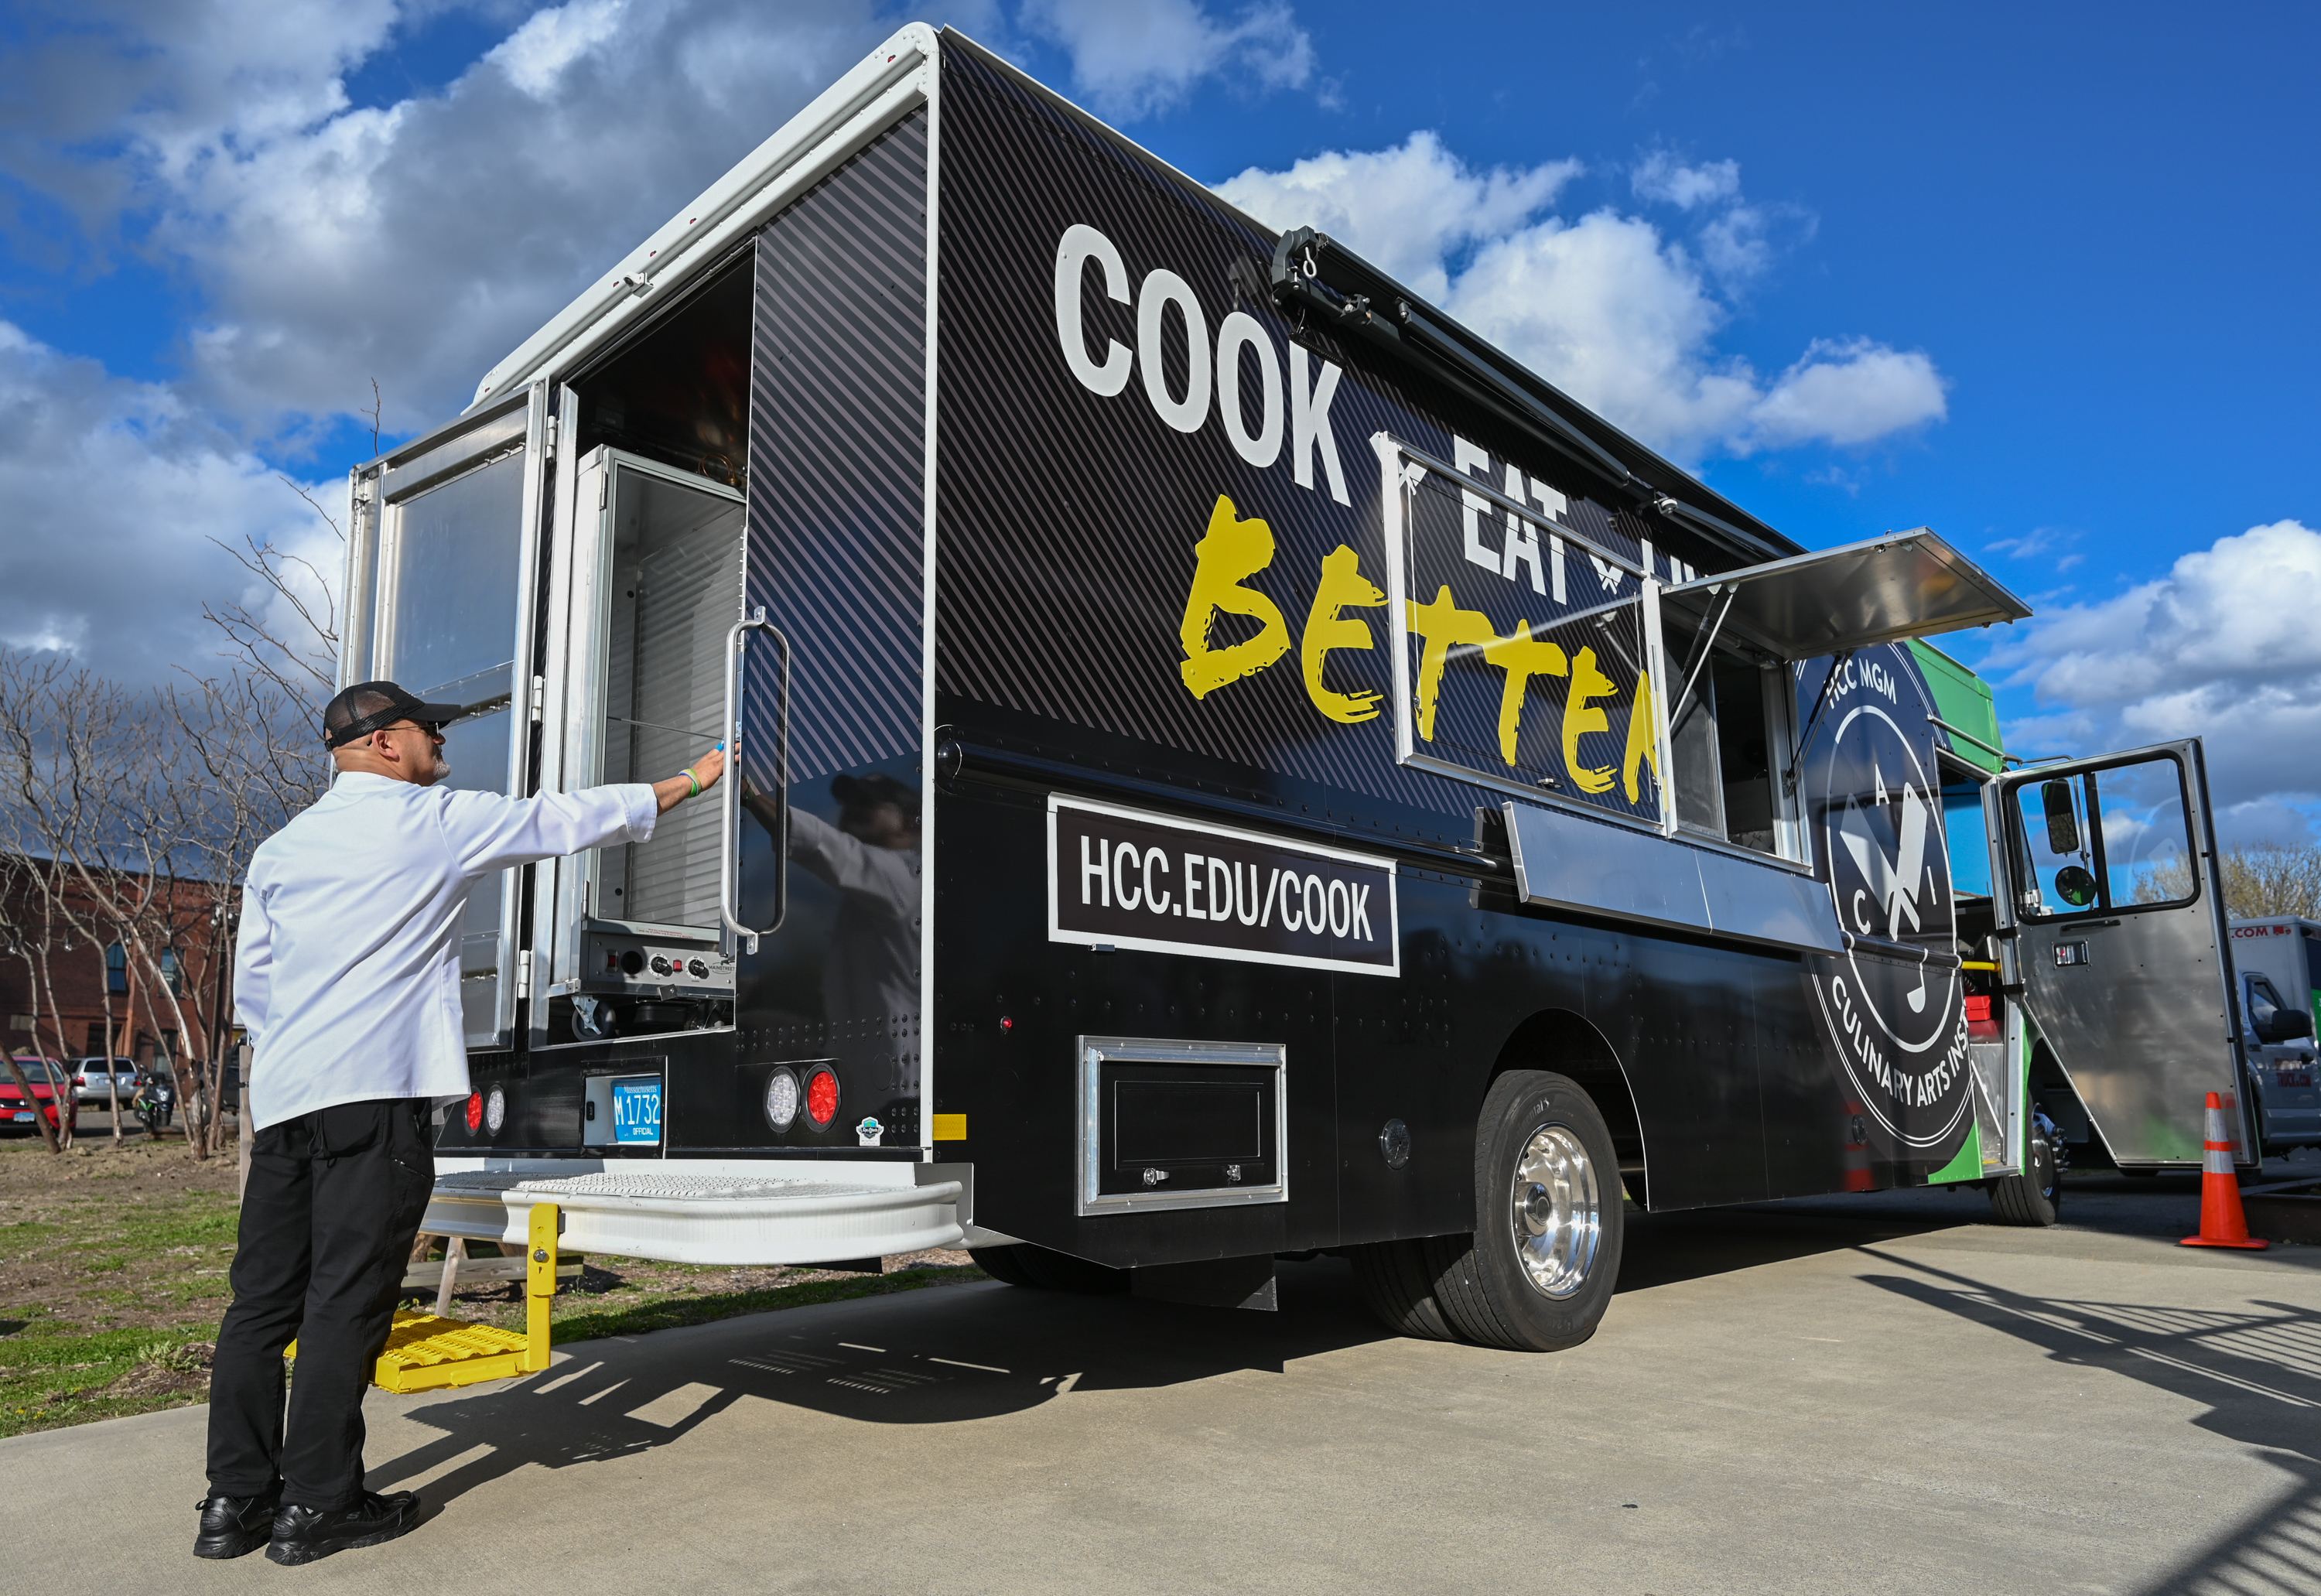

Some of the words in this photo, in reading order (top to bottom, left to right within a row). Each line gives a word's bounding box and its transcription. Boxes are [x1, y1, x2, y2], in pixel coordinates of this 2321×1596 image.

[1055, 224, 1351, 508] COOK
[1454, 434, 1567, 605] EAT
[1824, 658, 1857, 709] HCC
[1858, 658, 1896, 705] MGM
[1875, 764, 1890, 806] A
[1081, 835, 1373, 941] HCC.EDU/COOK
[1854, 889, 1871, 935] C
[1832, 976, 1913, 1106] CULINARY
[1917, 1060, 1950, 1107] ARTS
[624, 1085, 658, 1094] Massachusetts
[632, 1127, 654, 1136] OFFICIAL
